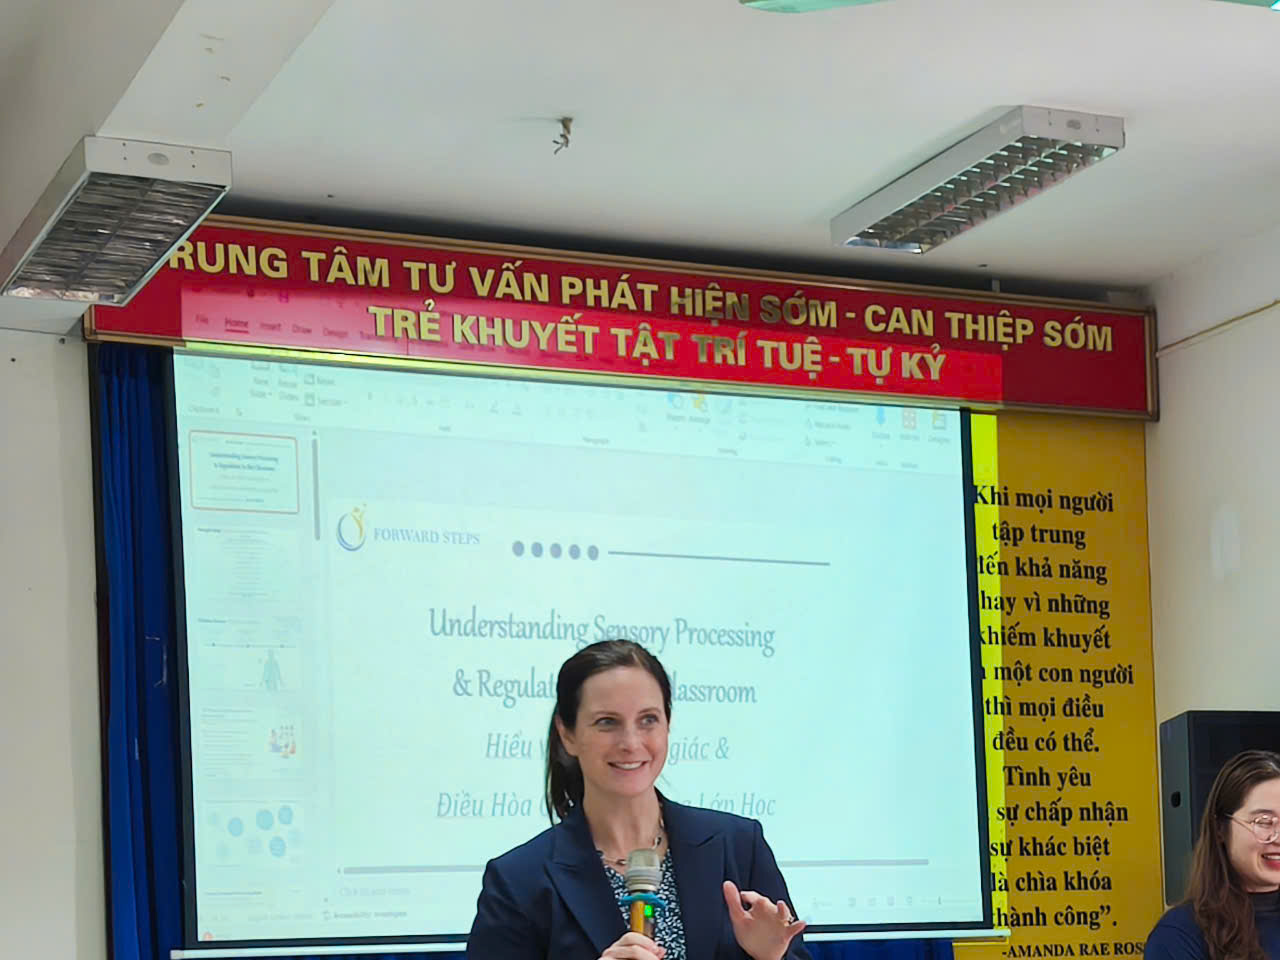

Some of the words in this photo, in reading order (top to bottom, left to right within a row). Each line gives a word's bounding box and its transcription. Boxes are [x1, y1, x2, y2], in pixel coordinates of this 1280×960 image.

[168, 239, 289, 280] RUNG
[301, 246, 390, 288] TÂM
[403, 261, 456, 294] TƯ
[469, 260, 549, 303] VẤN
[561, 273, 659, 312] PHÁT
[670, 282, 750, 327] HIỆN
[760, 290, 837, 329] SỚM
[845, 311, 856, 319] -
[864, 304, 934, 337] CAN
[944, 309, 1034, 351] THIỆP
[1043, 315, 1113, 352] SỚM
[368, 298, 441, 342] TRẺ
[453, 312, 600, 355] KHUYẾT
[610, 322, 681, 368] TẬT
[691, 330, 749, 367] TRÍ
[756, 336, 823, 380] TUỆ
[829, 355, 841, 364] -
[847, 346, 893, 385] TỰ
[901, 343, 946, 381] KỶ
[974, 485, 1009, 506] Khi
[1015, 488, 1053, 514] mọi
[1059, 491, 1114, 516] người
[373, 527, 440, 544] FORWARD
[442, 530, 481, 545] STEPS
[992, 520, 1025, 547] tập
[1030, 524, 1086, 550] trung
[1015, 555, 1053, 578] khả
[1058, 559, 1108, 586] năng
[980, 590, 1016, 616] hay
[1023, 591, 1041, 612] vì
[1047, 593, 1111, 620] những
[428, 604, 590, 651] Understanding
[593, 614, 670, 655] Sensory
[675, 617, 776, 658] Processing
[1043, 624, 1112, 654] khuyết
[452, 668, 473, 697] &
[477, 666, 556, 709] Regulat
[671, 670, 758, 704] lassroom
[994, 659, 1032, 687] một
[1038, 667, 1073, 683] con
[1079, 664, 1134, 689] người
[985, 695, 1012, 716] thì
[1019, 696, 1056, 722] mọi
[1062, 693, 1105, 718] điều
[714, 736, 730, 760] &
[992, 726, 1029, 751] đều
[1034, 731, 1057, 752] có
[1063, 727, 1100, 753] thể.
[1003, 765, 1051, 787] Tình
[1057, 766, 1092, 792] yêu
[490, 792, 533, 818] Hòa
[996, 803, 1020, 827] sự
[1025, 796, 1073, 827] chấp
[1079, 800, 1129, 827] nhận
[990, 838, 1013, 862] sự
[1018, 835, 1067, 857] khác
[1073, 835, 1111, 862] biệt
[991, 871, 1009, 892] là
[1016, 870, 1057, 892] chìa
[1063, 871, 1112, 892] khóa
[994, 906, 1047, 927] hành
[1001, 943, 1075, 959] -AMANDA
[1079, 942, 1111, 957] RAE
